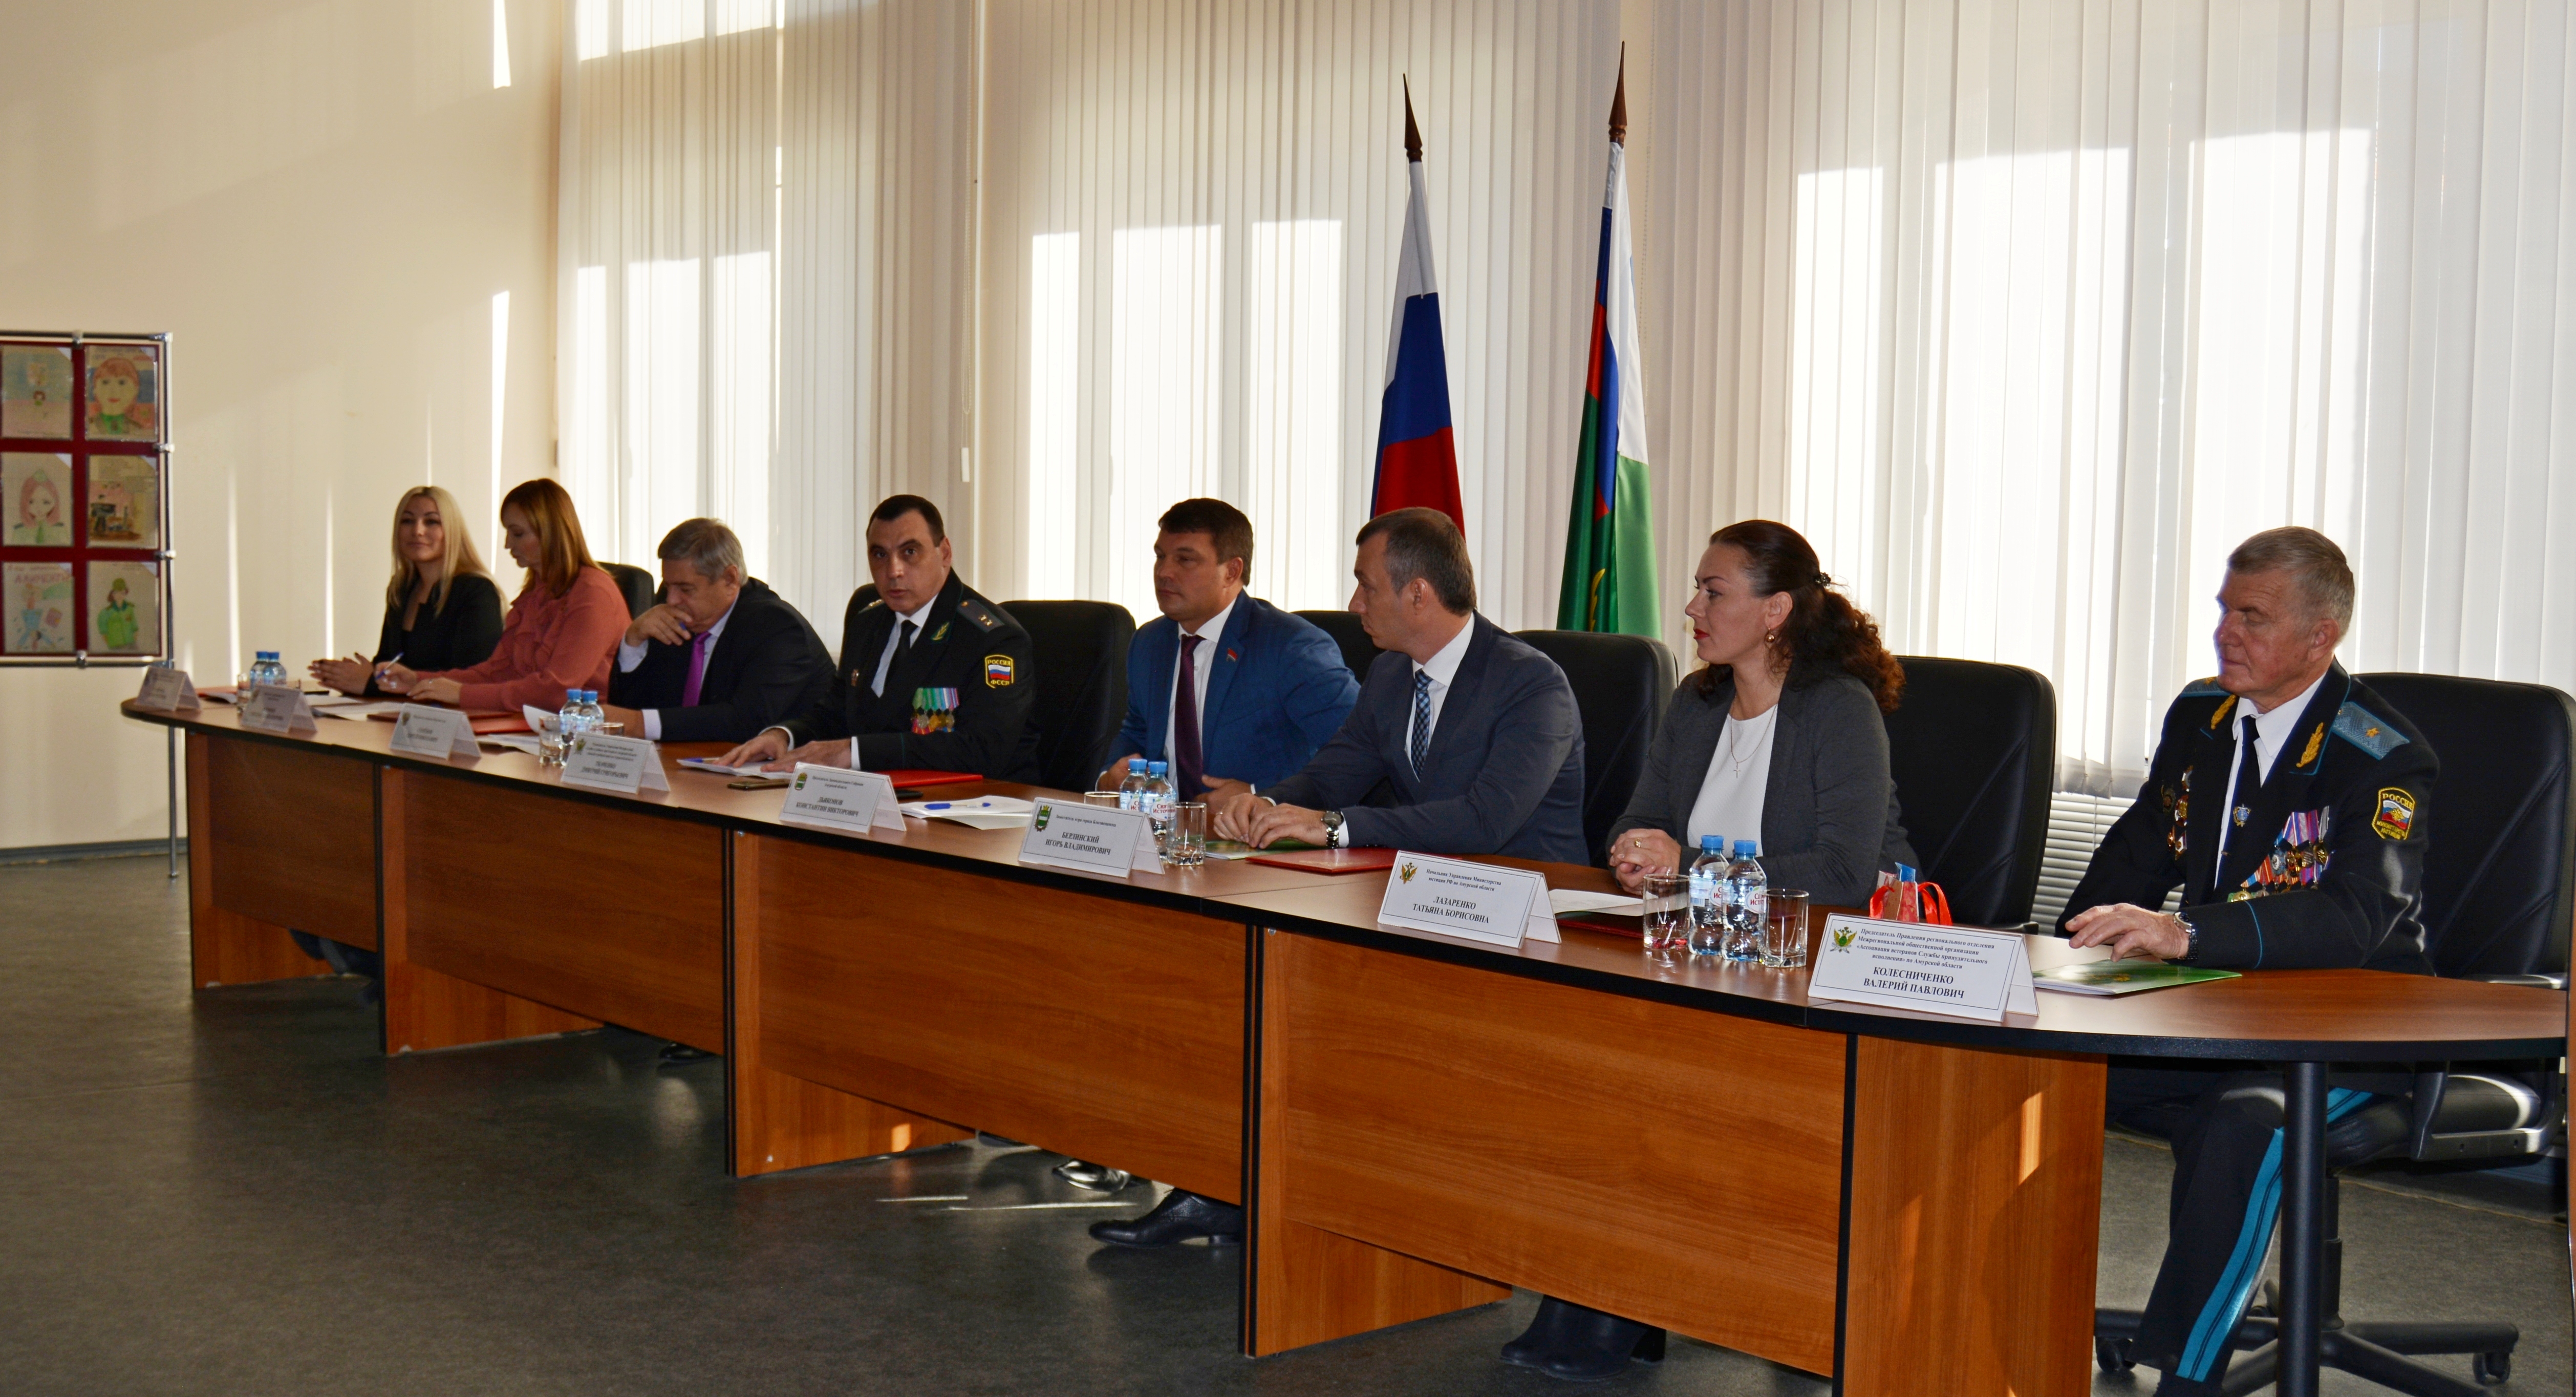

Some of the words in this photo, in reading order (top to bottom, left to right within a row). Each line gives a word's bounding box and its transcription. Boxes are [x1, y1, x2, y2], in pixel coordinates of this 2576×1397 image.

[2382, 793, 2413, 809] РОССИЯ
[796, 802, 826, 812] КОНСТАНТИН
[827, 807, 858, 817] ВИКТОРОВИЧ
[1062, 832, 1100, 843] БЕРЛИНСКИЙ
[1045, 839, 1063, 847] ИГОРЬ
[1064, 843, 1111, 855] ВЛАДИМИРОВИЧ
[1449, 873, 1472, 881] Управления
[1473, 876, 1501, 885] Министерства
[1433, 897, 1476, 909] ЛАЗАРЕНКО
[1413, 903, 1443, 916] ТАТЬЯНА
[1445, 910, 1489, 924] БОРИСОВНА
[1861, 928, 1895, 938] Председатель
[1897, 933, 1925, 941] Правления
[1926, 937, 1966, 945] регионального
[1858, 936, 1905, 946] Межрегиональной
[1906, 942, 1943, 951] общественной
[1945, 946, 1979, 955] организации
[1856, 944, 1890, 952] «Ассоциация
[1941, 955, 1988, 964] принудительного
[1872, 954, 1905, 962] исполнения»
[1873, 966, 1954, 984] КОЛЕСНИЧЕНКО
[1863, 978, 1908, 991] ВАЛЕРИЙ
[1910, 984, 1964, 999] ПАВЛОВИЧ
